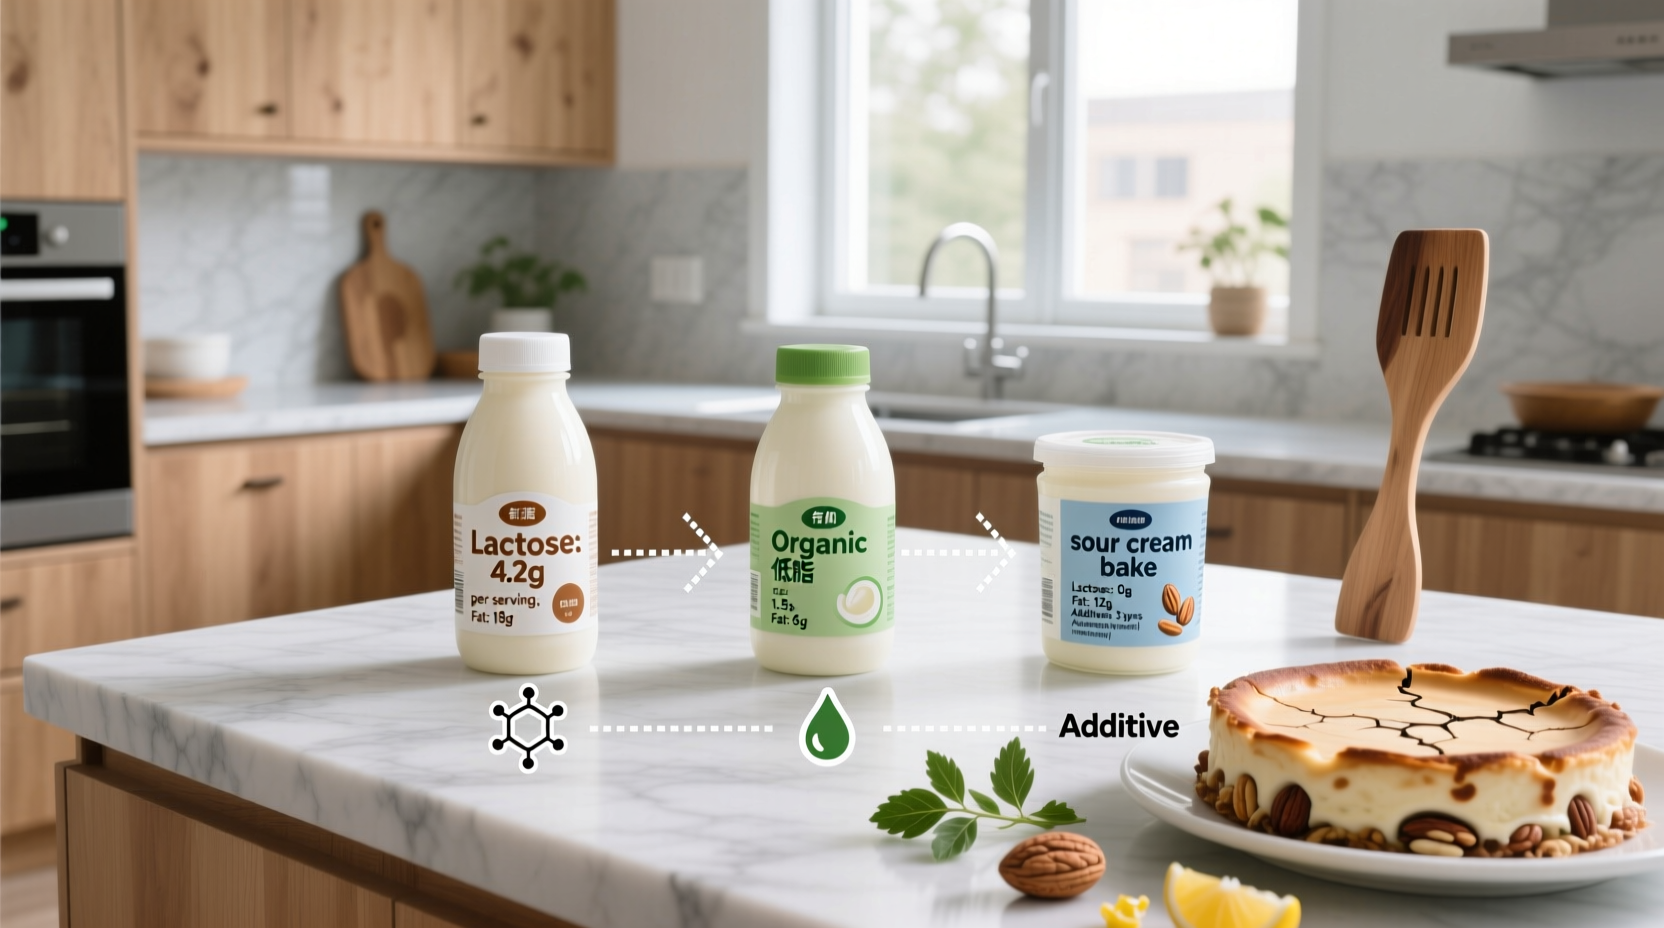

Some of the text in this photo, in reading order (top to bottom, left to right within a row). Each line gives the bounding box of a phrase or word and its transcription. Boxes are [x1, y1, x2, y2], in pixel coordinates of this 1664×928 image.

[471, 529, 582, 557] Lactose:
[771, 529, 867, 560] Organic
[1070, 533, 1193, 553] sour cream
[490, 559, 545, 590] 4.2g
[1100, 556, 1158, 578] bake
[471, 594, 489, 607] per
[1117, 584, 1133, 598] 0g
[471, 610, 490, 624] Fat:
[771, 613, 808, 630] Fat: 6g
